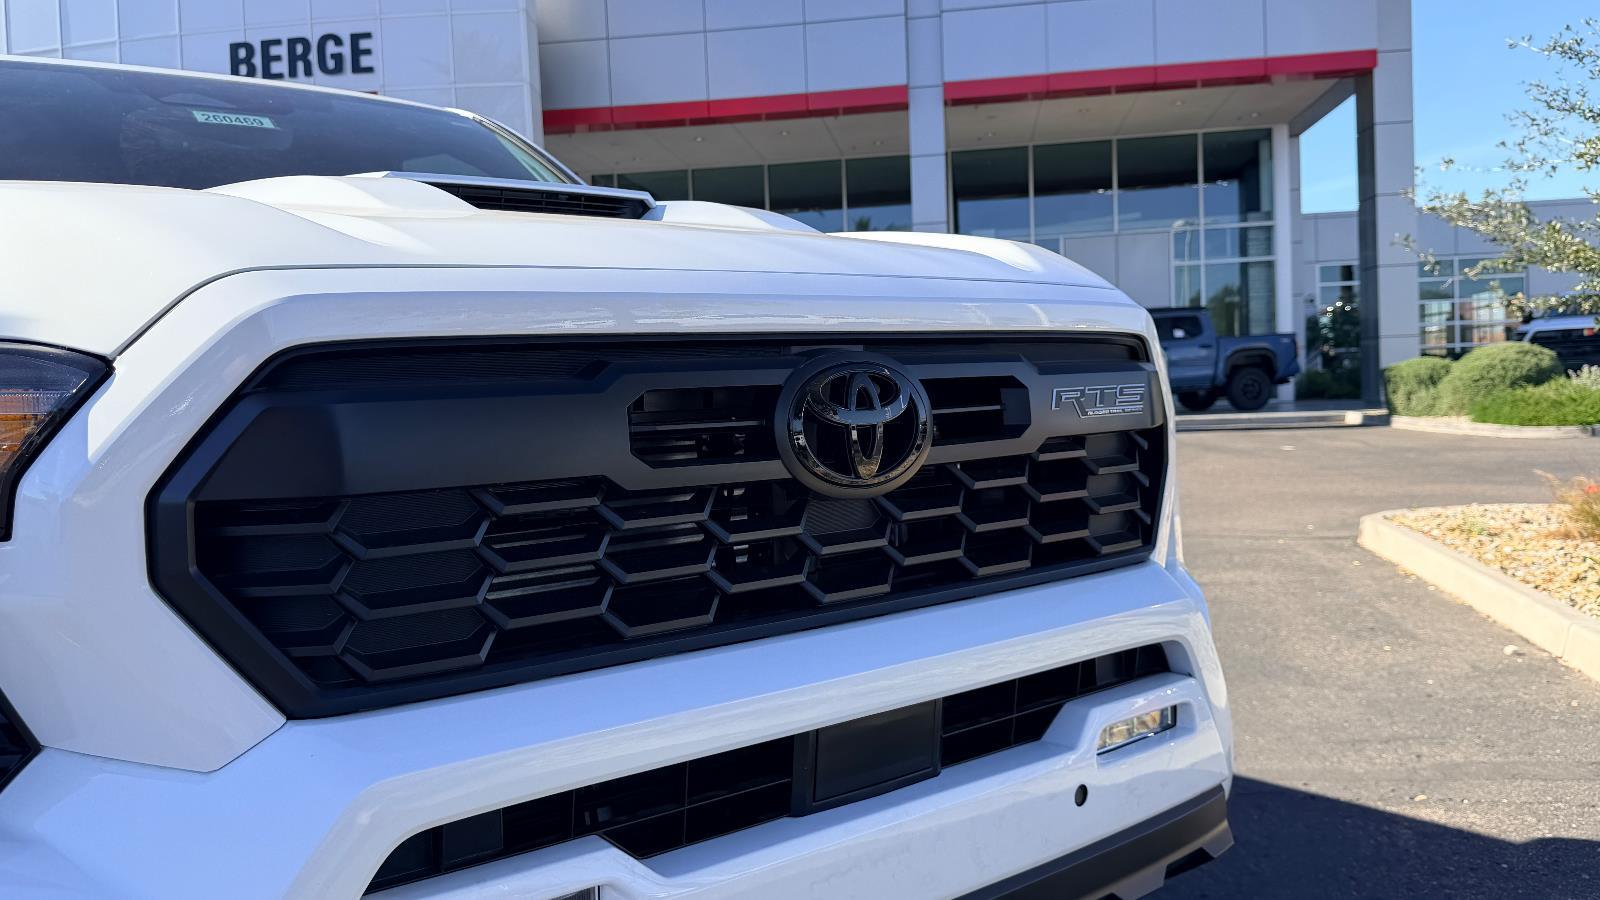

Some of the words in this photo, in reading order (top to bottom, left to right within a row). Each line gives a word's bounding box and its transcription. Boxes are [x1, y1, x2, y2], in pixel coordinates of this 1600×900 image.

[229, 32, 374, 79] BERGE
[200, 112, 265, 127] 260469
[1052, 384, 1145, 418] RTS
